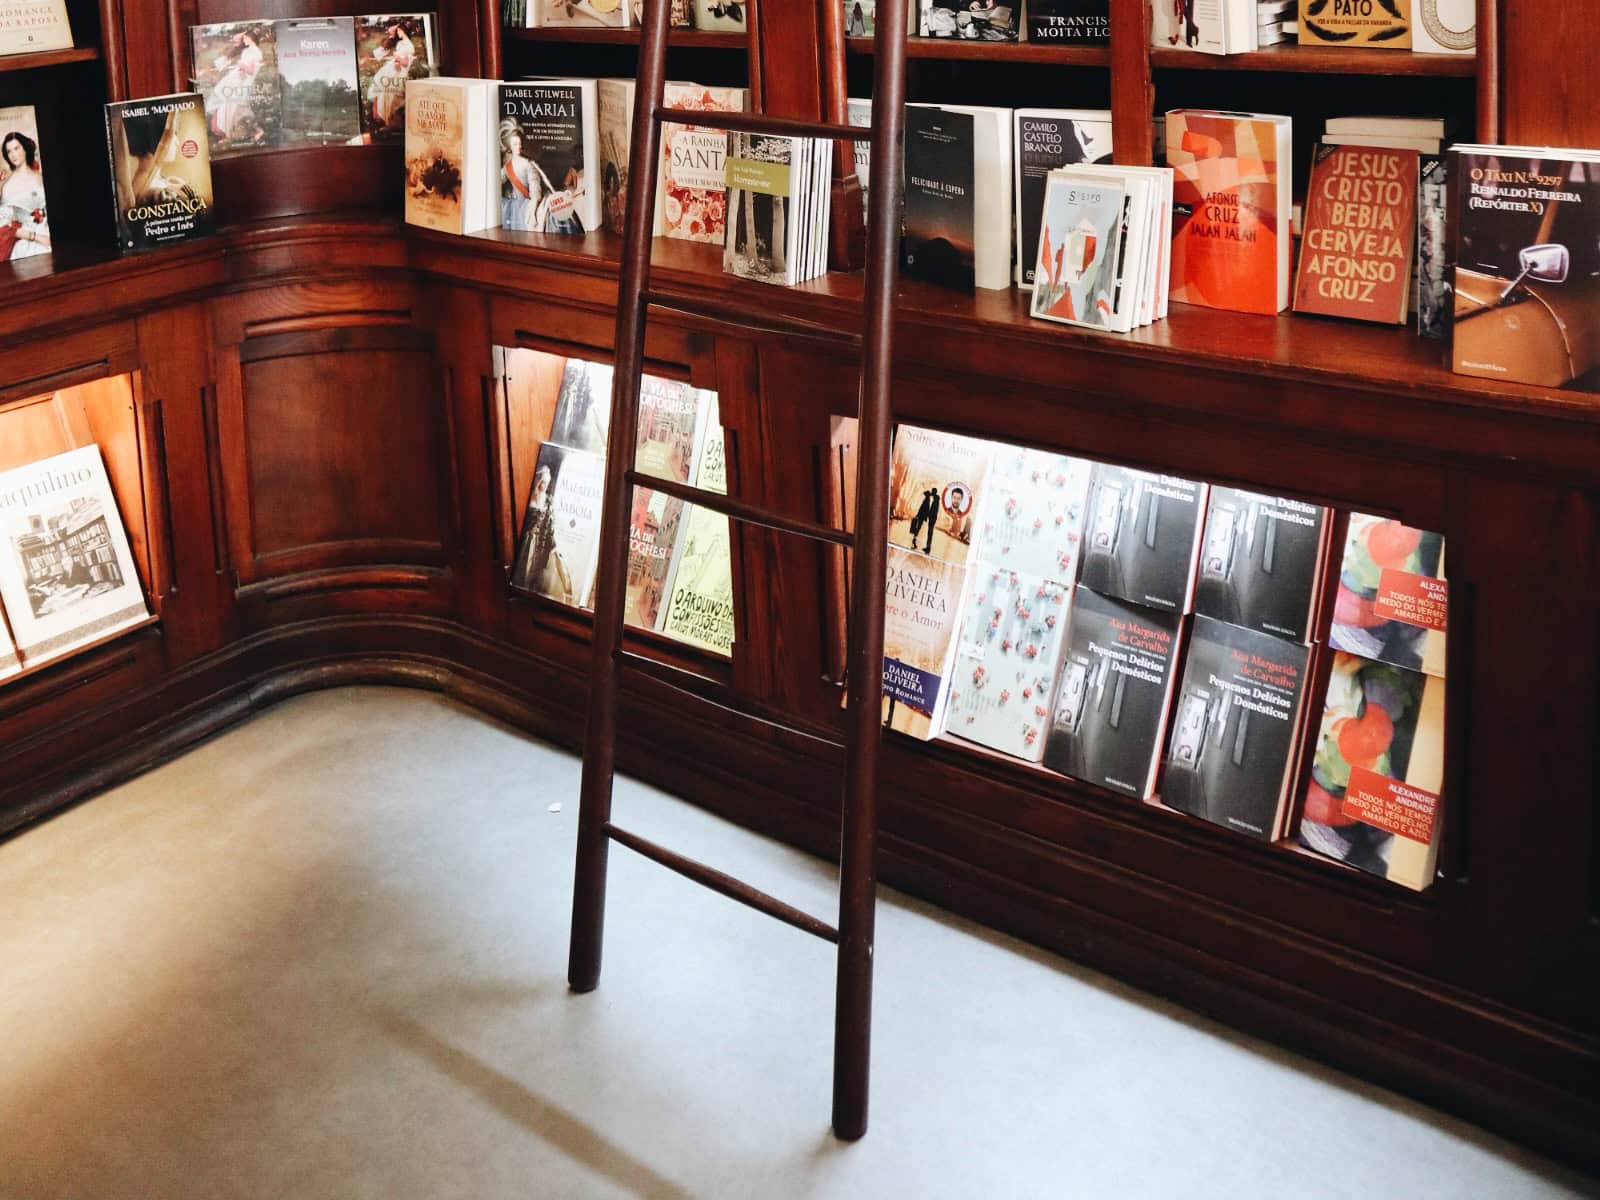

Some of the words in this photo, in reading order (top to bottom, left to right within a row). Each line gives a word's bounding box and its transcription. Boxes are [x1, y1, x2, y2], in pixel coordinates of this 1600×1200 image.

[1334, 0, 1372, 16] PATO
[1037, 27, 1081, 38] MOITA
[300, 40, 329, 49] Karen
[505, 89, 532, 98] ISABEL
[535, 90, 575, 99] STILWELL
[122, 107, 149, 118] ISABEL
[152, 102, 195, 114] MACHADO
[504, 102, 518, 115] D.
[521, 101, 567, 118] MARIA
[571, 104, 575, 117] I
[1024, 122, 1058, 133] CAMILO
[1024, 132, 1062, 144] CASTELO
[683, 136, 688, 144] A
[691, 135, 725, 149] RAINHA
[1024, 143, 1062, 154] BRANCO
[1332, 151, 1400, 177] JESUS
[1470, 169, 1483, 181] O
[1537, 176, 1562, 187] 9297
[1323, 177, 1403, 205] CRISTO
[1471, 183, 1526, 199] REINALDO
[1527, 188, 1581, 203] FERREIRA
[128, 197, 207, 221] CONSTANÇA
[1205, 206, 1240, 225] CRUZ
[1331, 202, 1395, 231] BEBIA
[1469, 198, 1530, 212] (REPÓRTER
[1530, 202, 1544, 215] X)
[145, 225, 169, 236] Pedro
[178, 222, 194, 230] Inês
[1191, 223, 1220, 239] JALAN
[1307, 228, 1405, 259] CERVEJA
[1306, 254, 1396, 282] AFONSO
[1318, 277, 1377, 303] CRUZ
[1259, 505, 1315, 528] Domésticos
[1278, 498, 1317, 515] Delírios
[886, 568, 943, 595] DANIEL
[675, 589, 684, 605] O
[685, 592, 722, 616] ARQUIVO
[886, 581, 946, 612] LIVEIRA
[1380, 595, 1402, 609] MEDO
[1389, 591, 1416, 604] TODOS
[1418, 598, 1435, 608] NÓS
[673, 607, 721, 632] CONFISSÕES
[911, 610, 944, 631] Amor
[1394, 609, 1432, 625] AMARELO
[1109, 618, 1125, 629] Ana
[1128, 620, 1170, 643] Margarida
[1118, 632, 1128, 642] de
[1130, 634, 1168, 654] Carvalho
[1088, 642, 1128, 662] Pequenos
[1129, 653, 1164, 673] Delírios
[1252, 654, 1298, 677] Margarida
[883, 672, 923, 694] OLIVEIRA
[888, 665, 920, 684] DANIEL
[1112, 662, 1162, 685] Domésticos
[1241, 664, 1252, 675] de
[1254, 667, 1295, 689] Carvalho
[1209, 674, 1252, 696] Pequenos
[1253, 687, 1292, 708] Delírios
[1233, 696, 1289, 721] Domésticos
[1347, 797, 1370, 812] MEDO
[1389, 783, 1437, 806] ALEXANDRE
[1395, 796, 1434, 814] ANDRADE
[1359, 791, 1383, 806] TODOS
[1385, 799, 1402, 812] NÓS
[1403, 806, 1432, 825] TEMOS
[1362, 810, 1399, 830] AMARELO
[1409, 825, 1430, 841] AZUL
